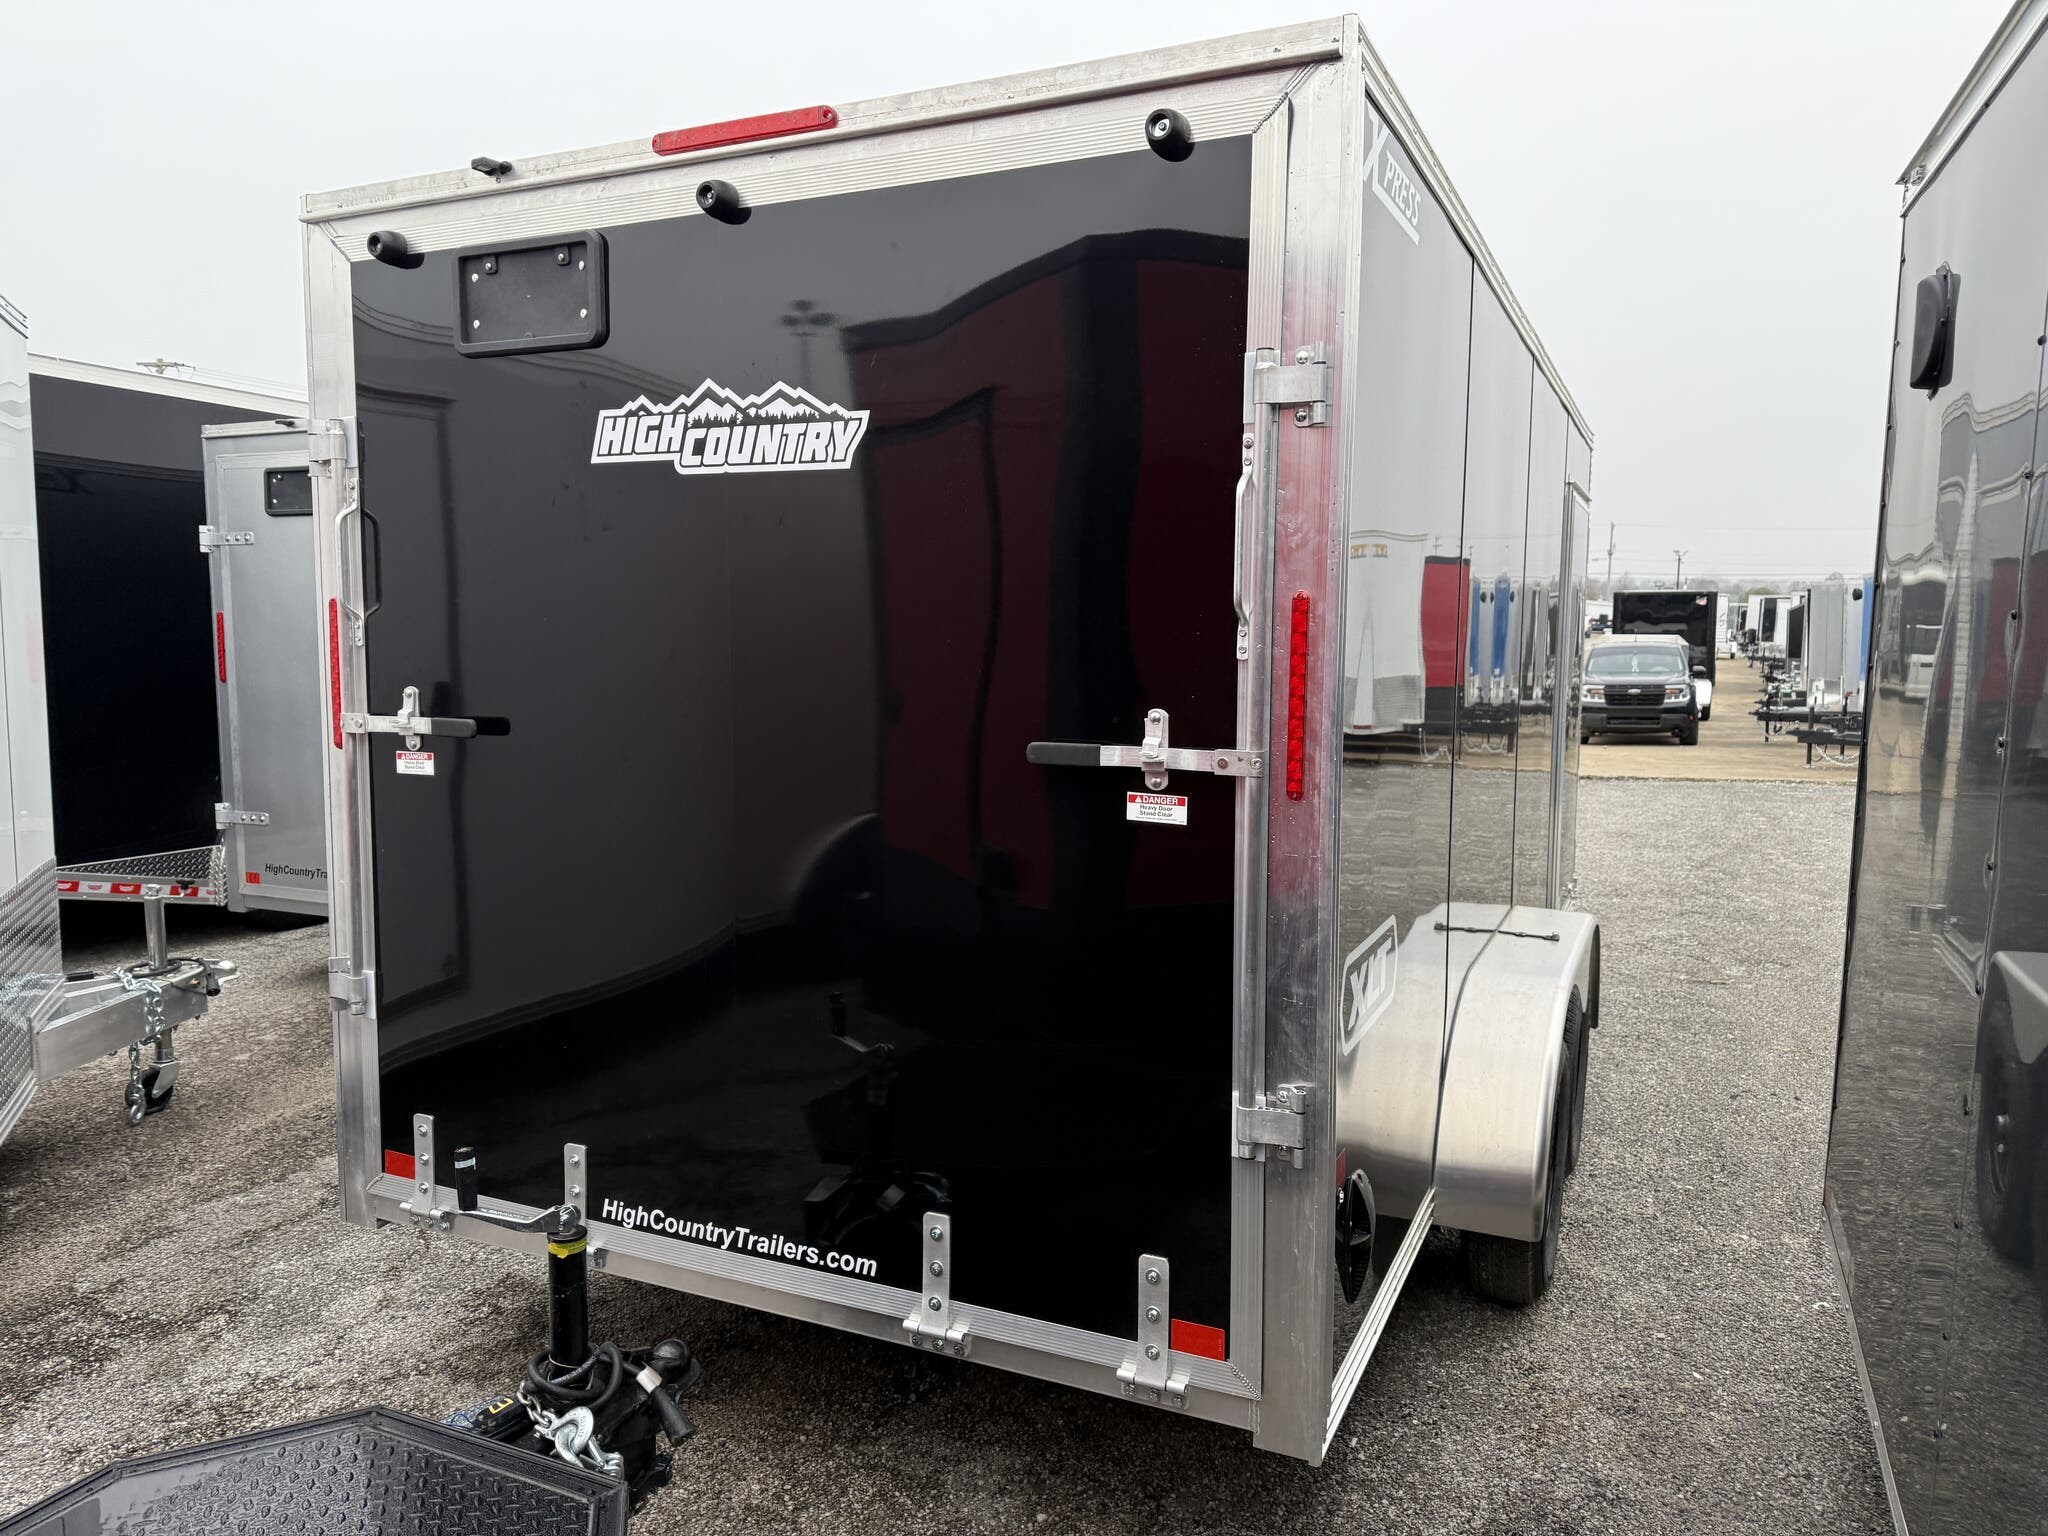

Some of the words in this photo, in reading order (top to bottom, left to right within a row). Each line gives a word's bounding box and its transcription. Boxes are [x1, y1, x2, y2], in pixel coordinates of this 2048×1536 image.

[598, 412, 687, 456] HIGH
[681, 419, 860, 467] COUNTRY
[1143, 796, 1178, 805] DANGER
[1347, 936, 1392, 1032] XLT
[602, 1197, 877, 1277] HighCountryTrailers.com
